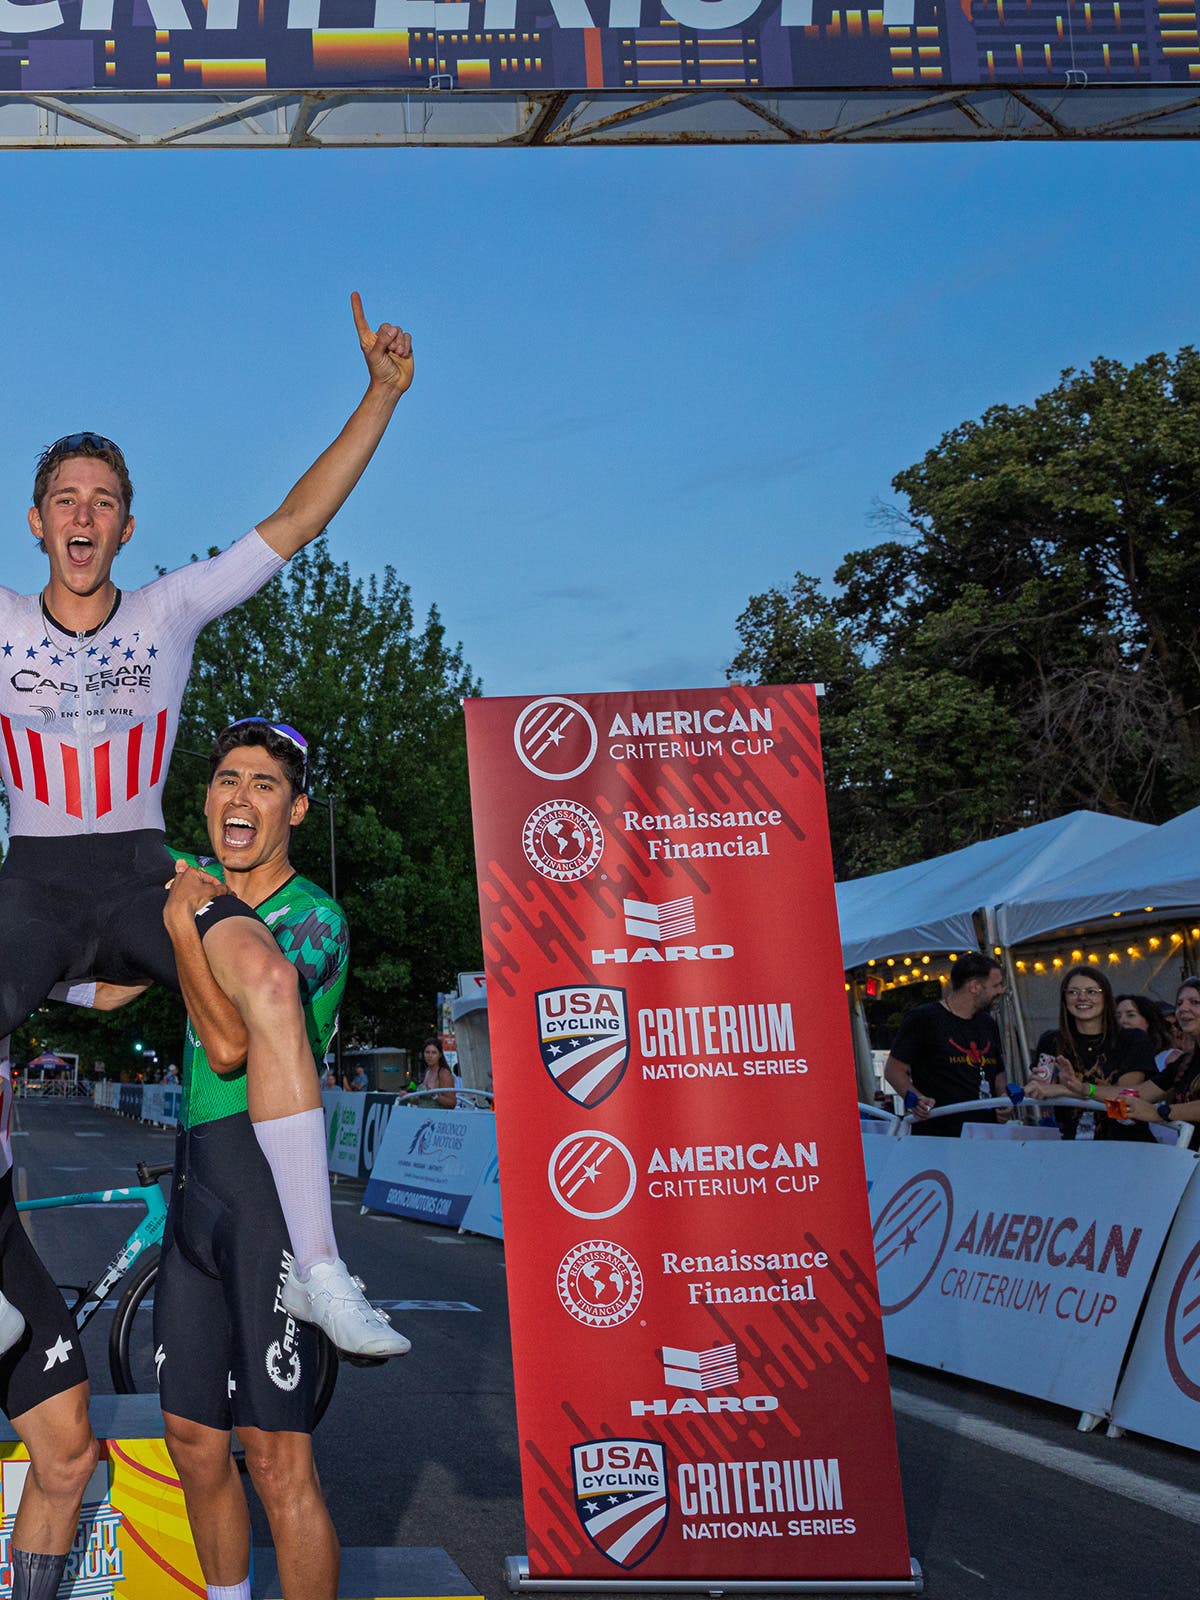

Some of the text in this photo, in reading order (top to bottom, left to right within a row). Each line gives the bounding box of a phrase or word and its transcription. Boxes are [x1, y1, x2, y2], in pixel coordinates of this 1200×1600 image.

[85, 665, 151, 682] TEAM
[61, 708, 134, 718] ENCORE WIRE
[608, 708, 773, 737] AMERICAN
[609, 738, 774, 760] CRITERIUM CUP
[535, 811, 590, 834] RENAISSANCE
[623, 807, 782, 831] Renaissance
[648, 833, 769, 860] Financial
[542, 854, 588, 871] FINANCIAL
[591, 944, 734, 964] HARO
[545, 993, 619, 1017] USA
[546, 1017, 620, 1034] CYCLING
[638, 1003, 796, 1058] CRITERIUM
[642, 1059, 809, 1080] NATIONAL SERIES
[436, 1122, 467, 1137] BRONCO
[433, 1135, 464, 1150] MOTORS
[647, 1142, 819, 1174] AMERICAN
[648, 1175, 820, 1199] CRITERIUM CUP
[386, 1188, 453, 1216] BRONCOMOTORS.COM
[954, 1208, 1143, 1279] AMERICAN
[570, 1251, 629, 1277] RENAISSANCE
[661, 1248, 828, 1275] Renaissance
[76, 1239, 142, 1331] ARO
[688, 1275, 816, 1305] Financial
[940, 1267, 1117, 1327] CRITERIUM CUP
[576, 1299, 627, 1316] FINANCIAL
[630, 1395, 778, 1417] HARO
[580, 1446, 658, 1473] USA
[582, 1472, 659, 1489] CYCLING
[677, 1458, 843, 1516] CRITERIUM
[682, 1518, 857, 1540] NATIONAL SERIES
